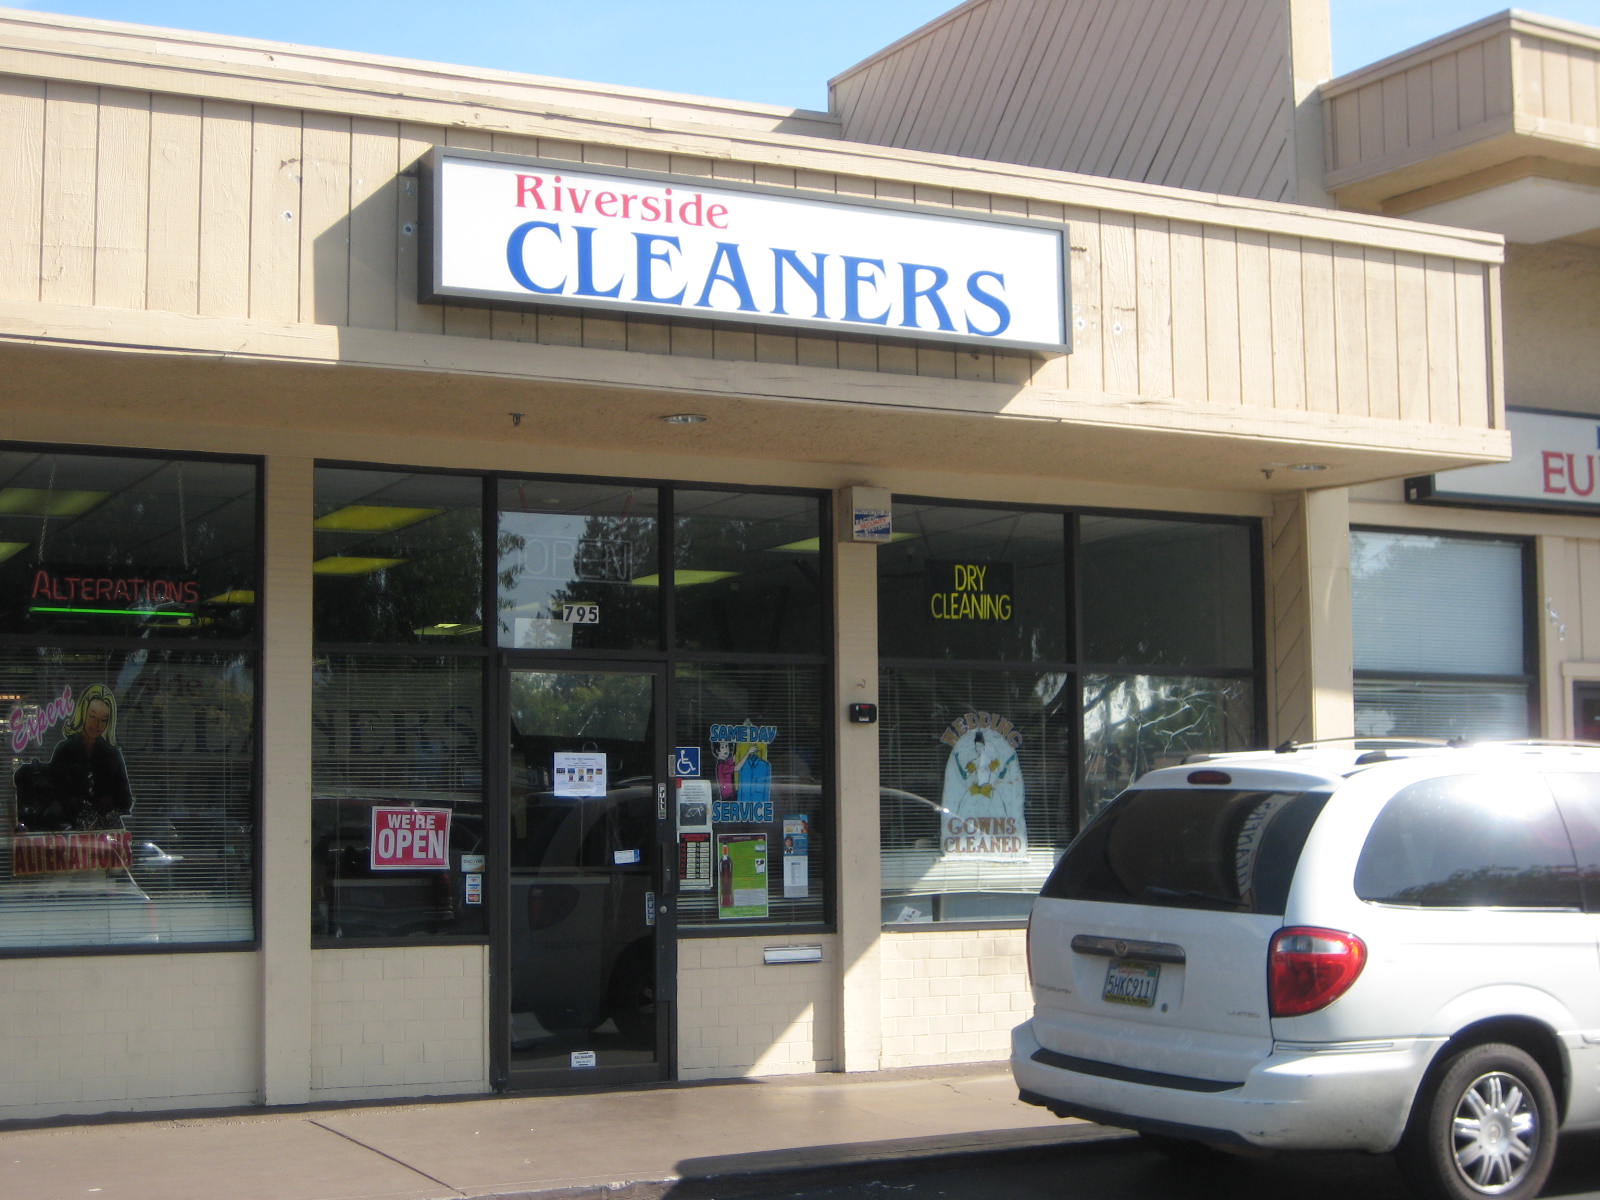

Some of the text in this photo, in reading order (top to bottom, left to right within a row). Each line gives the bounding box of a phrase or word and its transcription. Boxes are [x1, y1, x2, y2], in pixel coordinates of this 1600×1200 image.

[514, 172, 729, 230] Riverside
[506, 220, 1011, 337] CLEANERS
[1541, 450, 1600, 497] EU
[524, 538, 628, 581] OPEN
[32, 570, 199, 603] ALTERATIONS
[954, 564, 987, 592] DRY
[564, 605, 598, 622] 795
[930, 592, 1012, 621] CLEANING
[10, 685, 75, 751] Expert
[710, 725, 777, 744] SAME DAY
[387, 813, 436, 829] WE'RE
[712, 801, 773, 823] SERVICE
[947, 817, 1017, 835] GOWNS
[15, 831, 133, 874] ALTERATIONS
[378, 828, 446, 859] OPEN
[943, 836, 1022, 853] CLEANED
